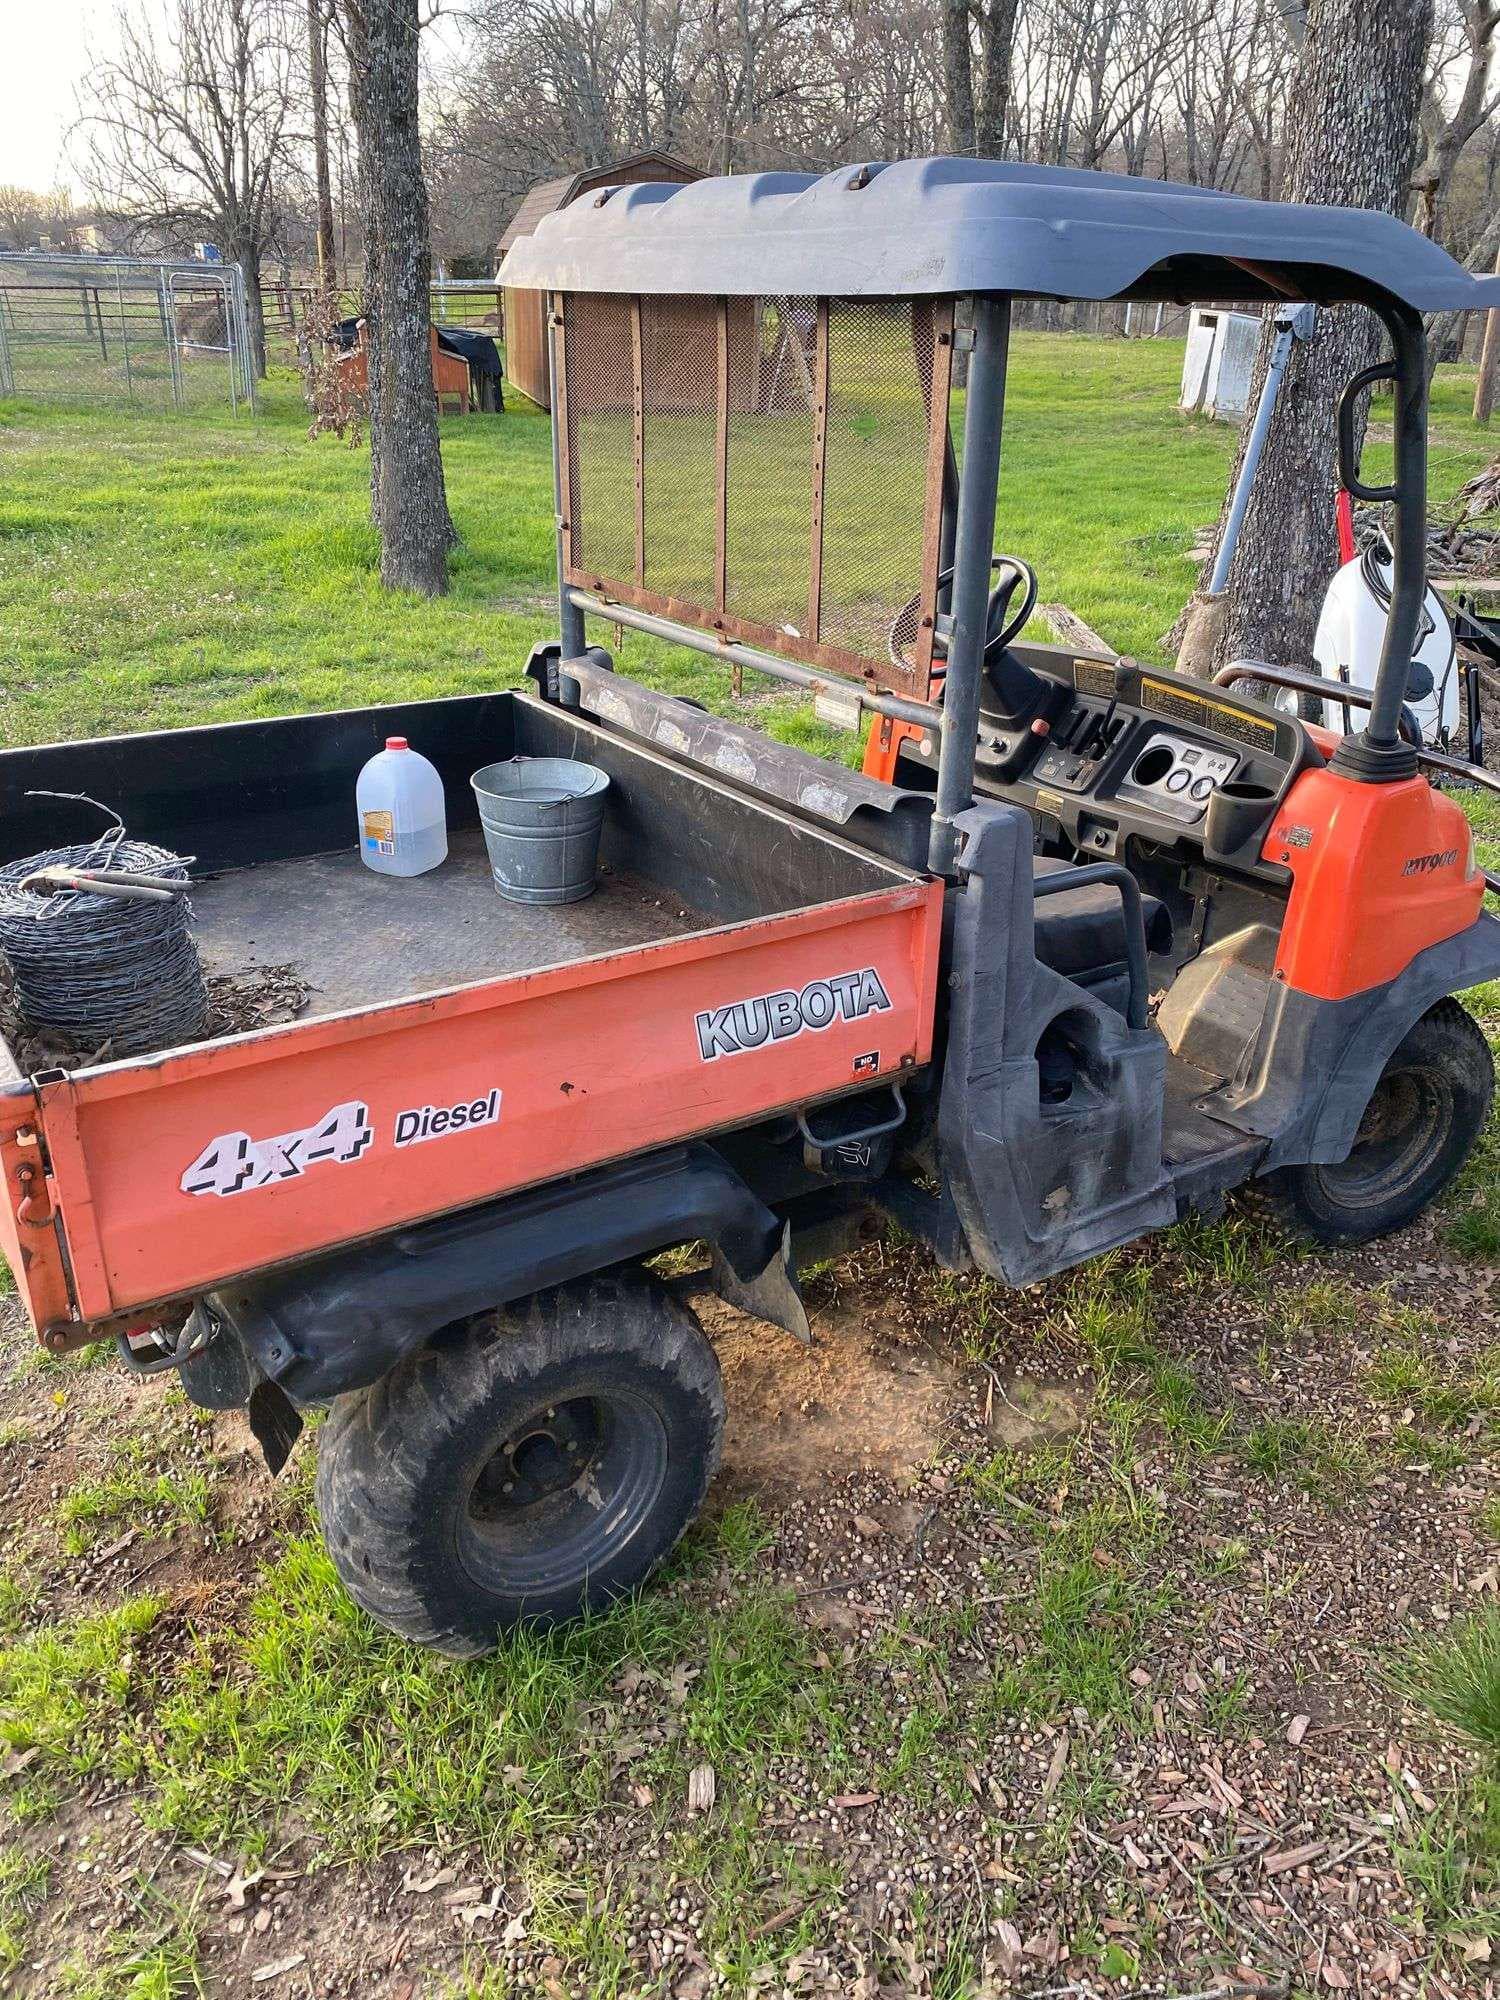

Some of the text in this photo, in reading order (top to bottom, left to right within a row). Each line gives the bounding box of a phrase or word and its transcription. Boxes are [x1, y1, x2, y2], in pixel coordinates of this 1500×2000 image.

[696, 969, 891, 1060] KUBOTA
[860, 1056, 873, 1066] NO
[181, 1091, 498, 1195] 4x4 Diesel
